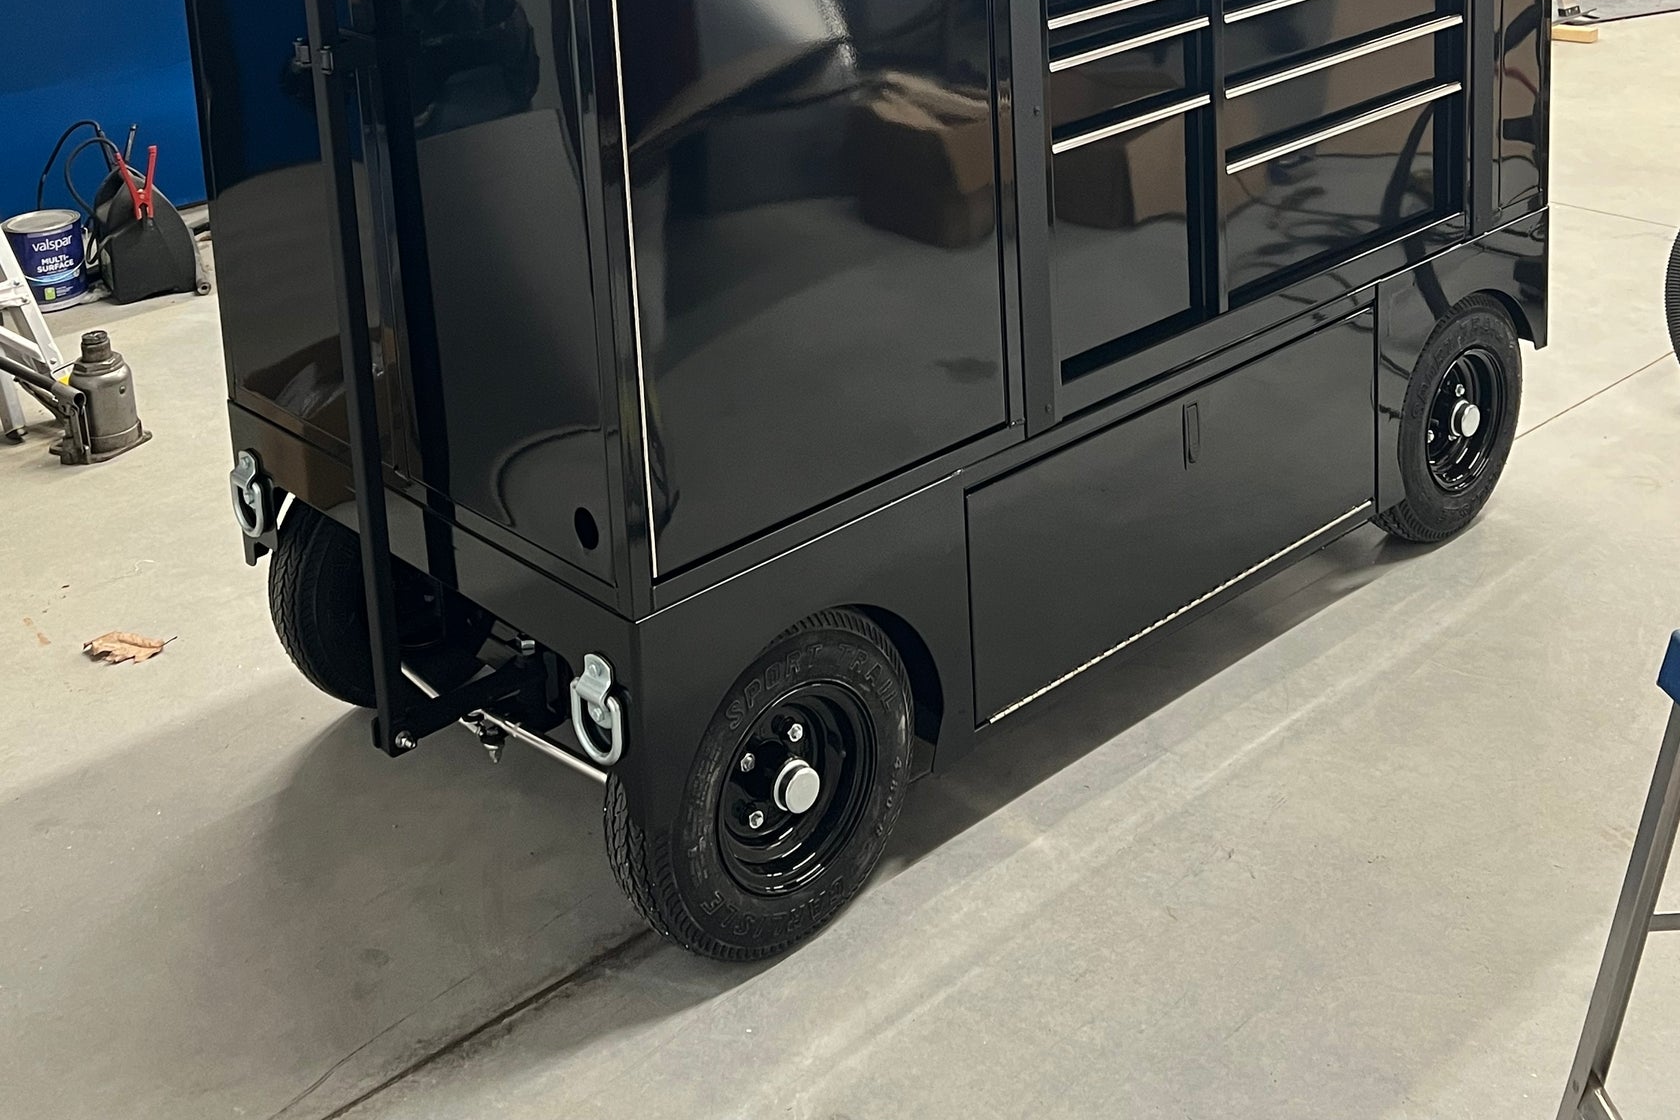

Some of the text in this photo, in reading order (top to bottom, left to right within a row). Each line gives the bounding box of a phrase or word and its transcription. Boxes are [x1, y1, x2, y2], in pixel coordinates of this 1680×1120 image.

[32, 235, 73, 252] valspar
[36, 259, 74, 273] SURFACE
[41, 254, 69, 266] MULTI-
[725, 643, 898, 730] SPORT TRAIL
